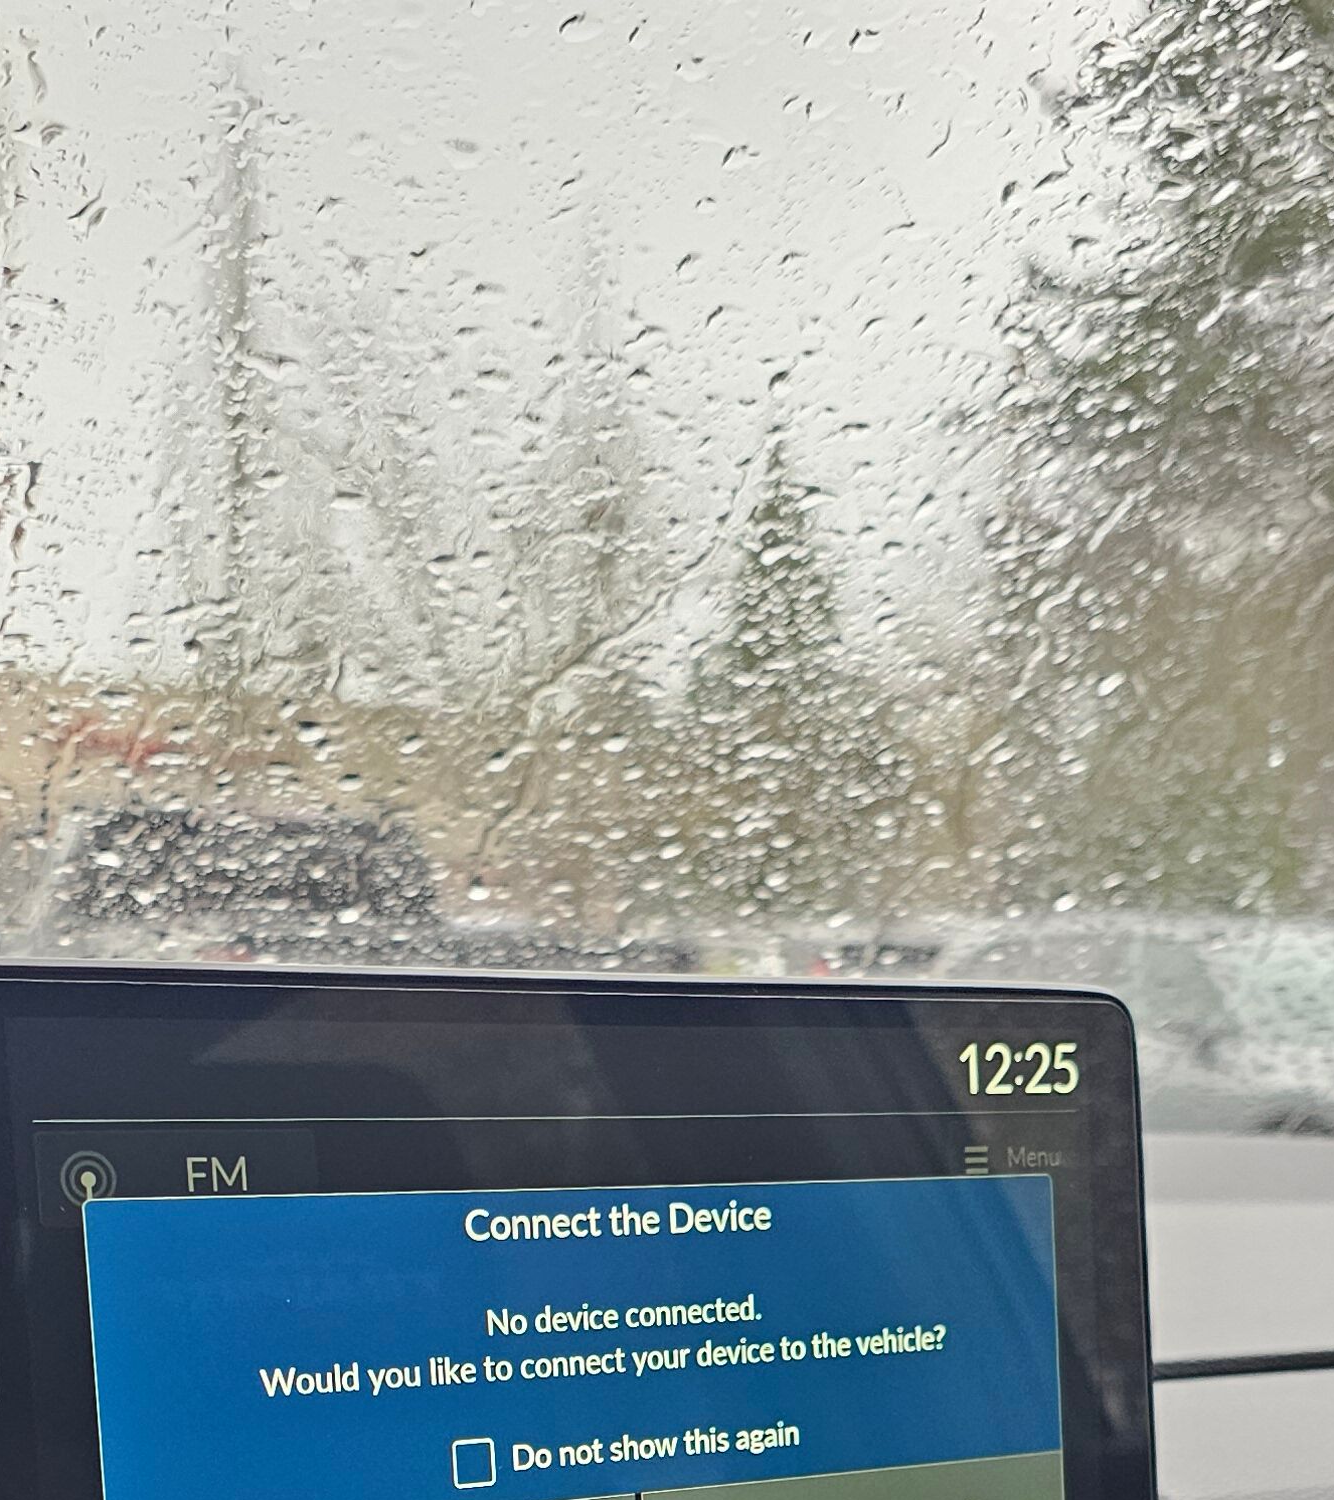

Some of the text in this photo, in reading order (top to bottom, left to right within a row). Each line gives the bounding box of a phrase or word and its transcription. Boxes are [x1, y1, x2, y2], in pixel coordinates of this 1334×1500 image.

[959, 1042, 1079, 1095] 12:25
[185, 1156, 249, 1193] FM
[1007, 1147, 1062, 1168] Menu
[465, 1200, 772, 1242] Connect the Device
[486, 1293, 762, 1336] No device connected.
[259, 1324, 947, 1397] Would you like to connect your device to the vehicle?
[512, 1420, 800, 1471] Do not show this again
